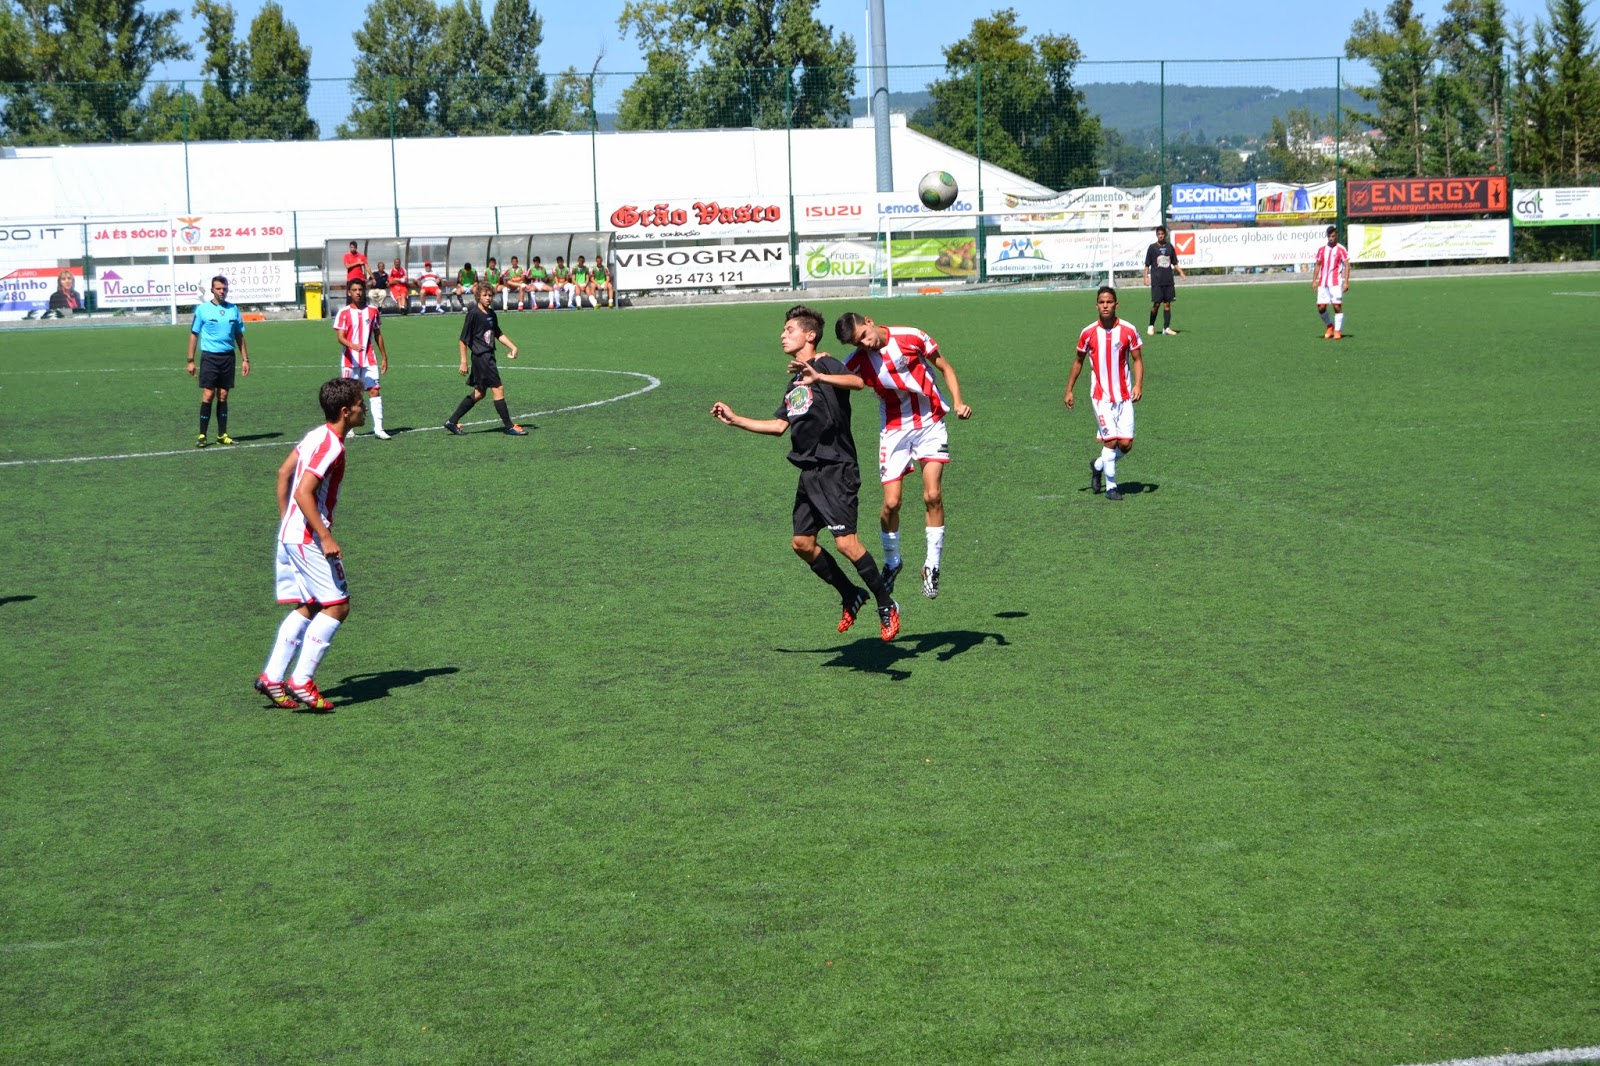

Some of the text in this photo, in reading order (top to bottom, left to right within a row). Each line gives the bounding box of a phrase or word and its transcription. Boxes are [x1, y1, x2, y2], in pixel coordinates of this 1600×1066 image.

[1176, 187, 1251, 203] DECATHLON
[1371, 181, 1480, 203] ENERGY
[878, 202, 920, 214] Lemos
[1372, 202, 1480, 213] www.energyurbanstores.com
[1516, 190, 1544, 214] cat
[610, 201, 781, 228] Grão Vasco
[805, 205, 862, 217] ISUZU
[40, 228, 64, 240] IT
[94, 229, 110, 240] JÁ
[113, 228, 128, 239] ÉS
[131, 228, 168, 240] SÓCIO
[209, 226, 283, 238] 232 441 350
[1198, 229, 1327, 244] soluções globais de negócio
[616, 247, 782, 268] VISOGRAN
[830, 251, 860, 260] Frutas
[1272, 250, 1318, 260] www.visa
[218, 264, 281, 276] 232 471 215
[240, 276, 259, 285] 910
[262, 275, 281, 285] 077
[656, 271, 744, 285] 925 473 121
[103, 279, 198, 295] Maco Fonelo
[3, 291, 27, 302] 480
[1098, 414, 1106, 427] 6
